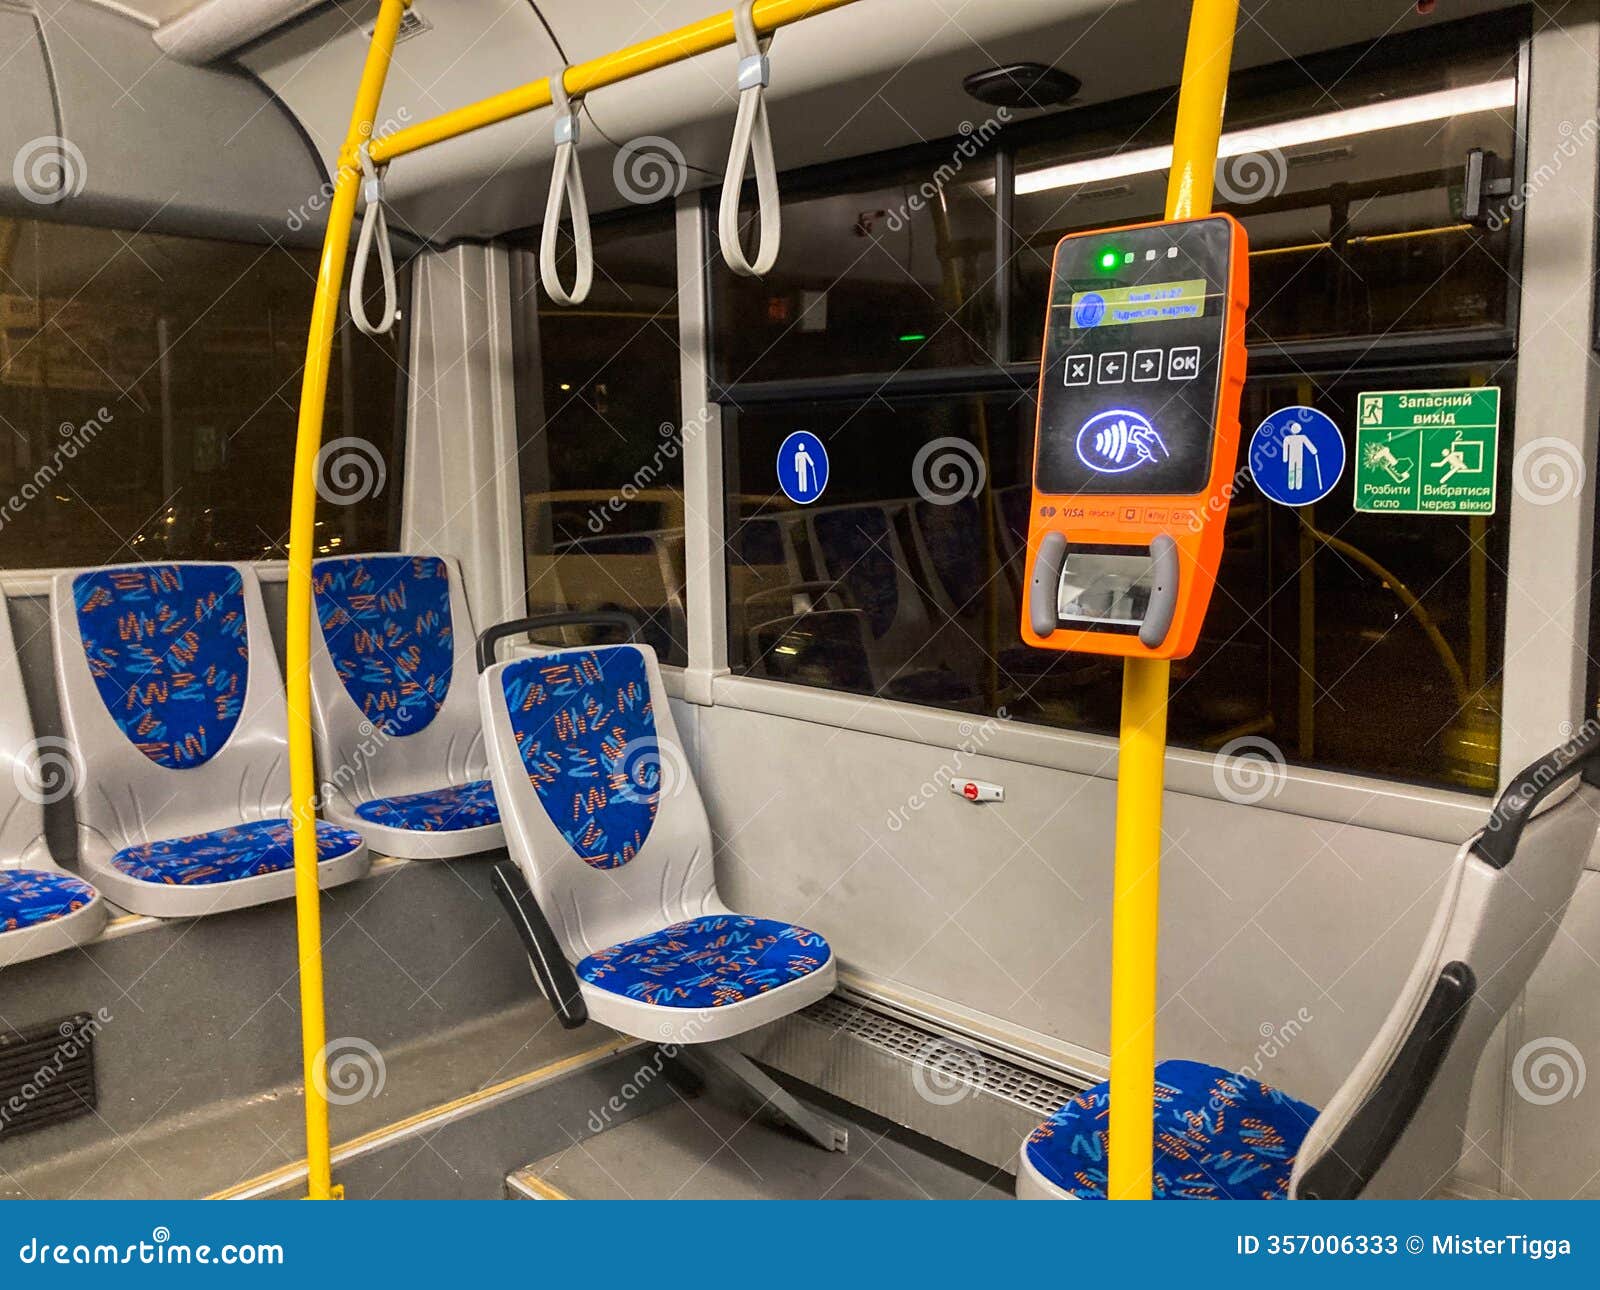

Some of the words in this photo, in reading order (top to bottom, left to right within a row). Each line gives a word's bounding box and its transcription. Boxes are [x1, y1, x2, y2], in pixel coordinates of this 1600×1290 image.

[1172, 356, 1196, 370] OK
[1398, 393, 1472, 408] Запасний
[1413, 411, 1455, 424] вихід
[1386, 432, 1392, 442] 1
[1455, 431, 1463, 441] 2
[1364, 484, 1410, 495] Розбити
[1424, 484, 1490, 497] Вибратися
[1373, 500, 1400, 509] скло
[1421, 500, 1456, 511] через
[1459, 499, 1492, 510] вікно
[1063, 508, 1084, 518] VISA
